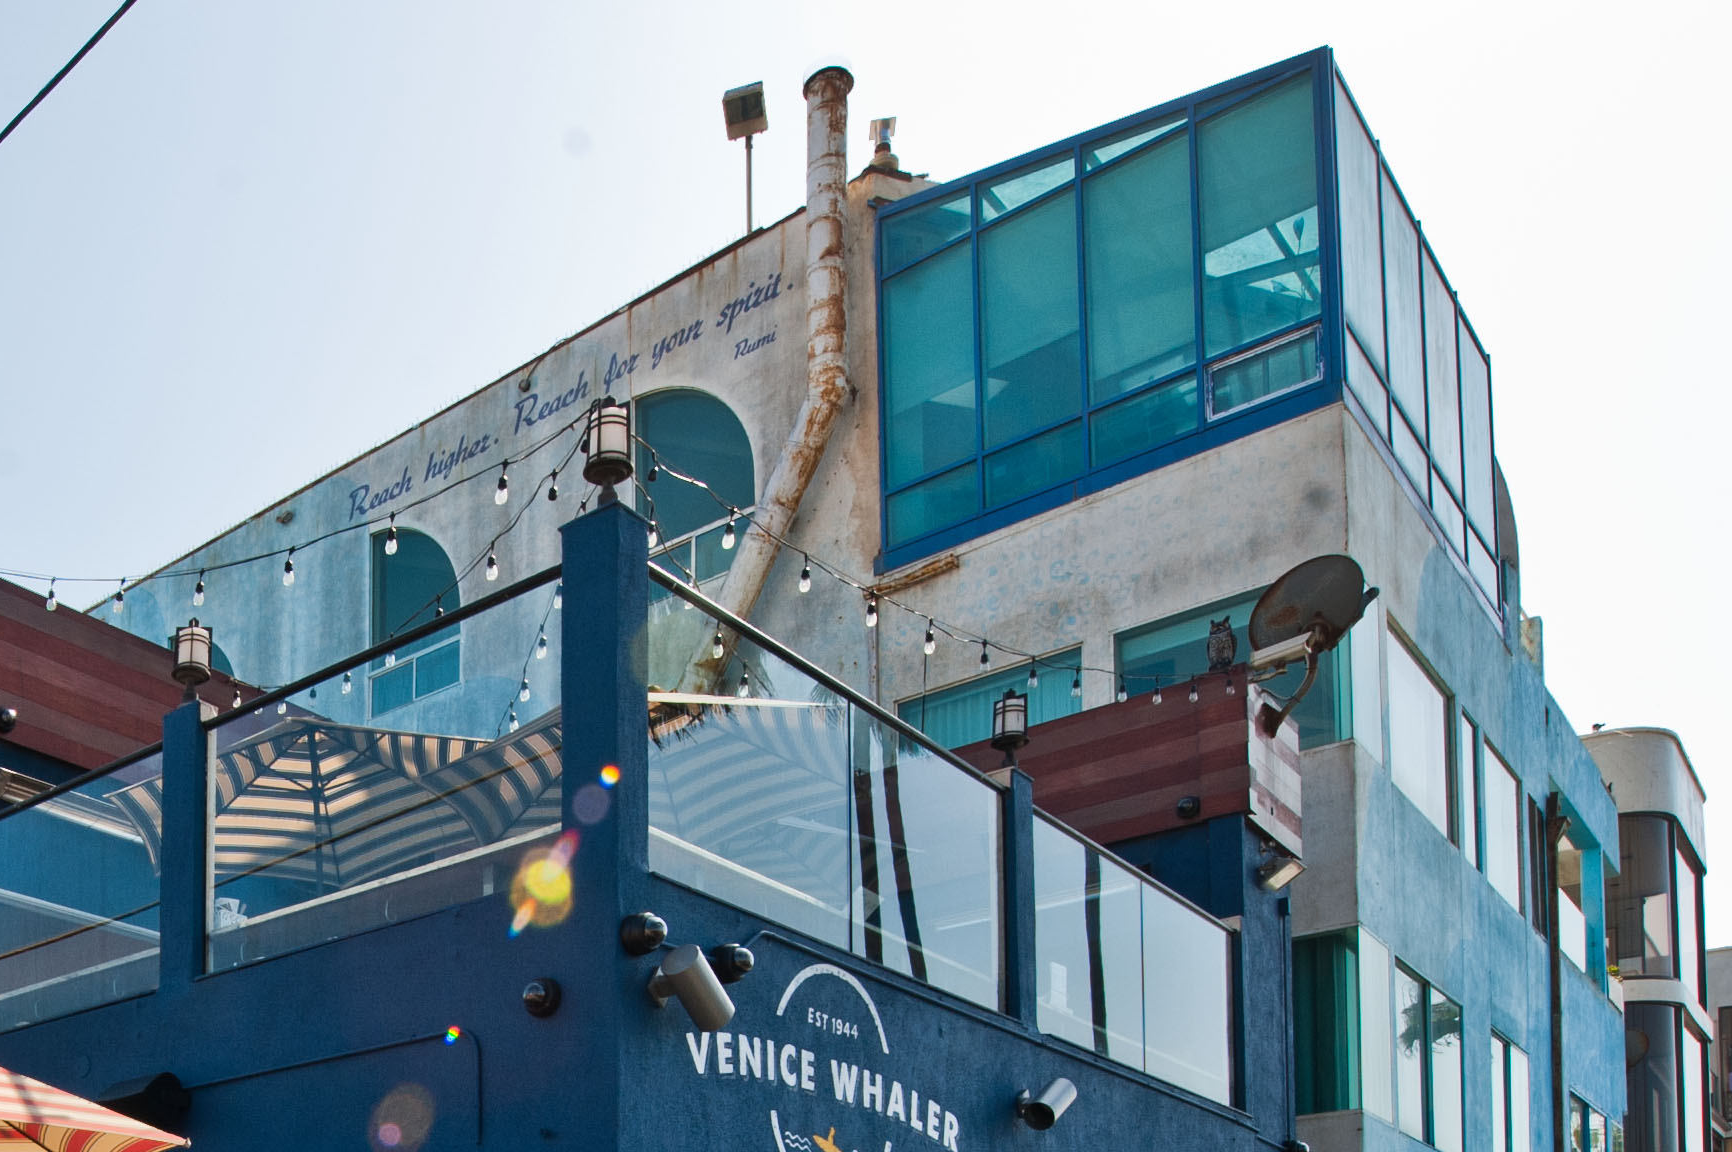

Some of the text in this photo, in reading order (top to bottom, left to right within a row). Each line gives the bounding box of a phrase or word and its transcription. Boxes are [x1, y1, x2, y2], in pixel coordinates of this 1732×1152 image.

[733, 324, 779, 360] Rumi
[348, 271, 795, 521] Reach higher. Reach for your spirit.
[807, 1007, 859, 1040] EST 1944
[685, 1031, 816, 1092] VENICE
